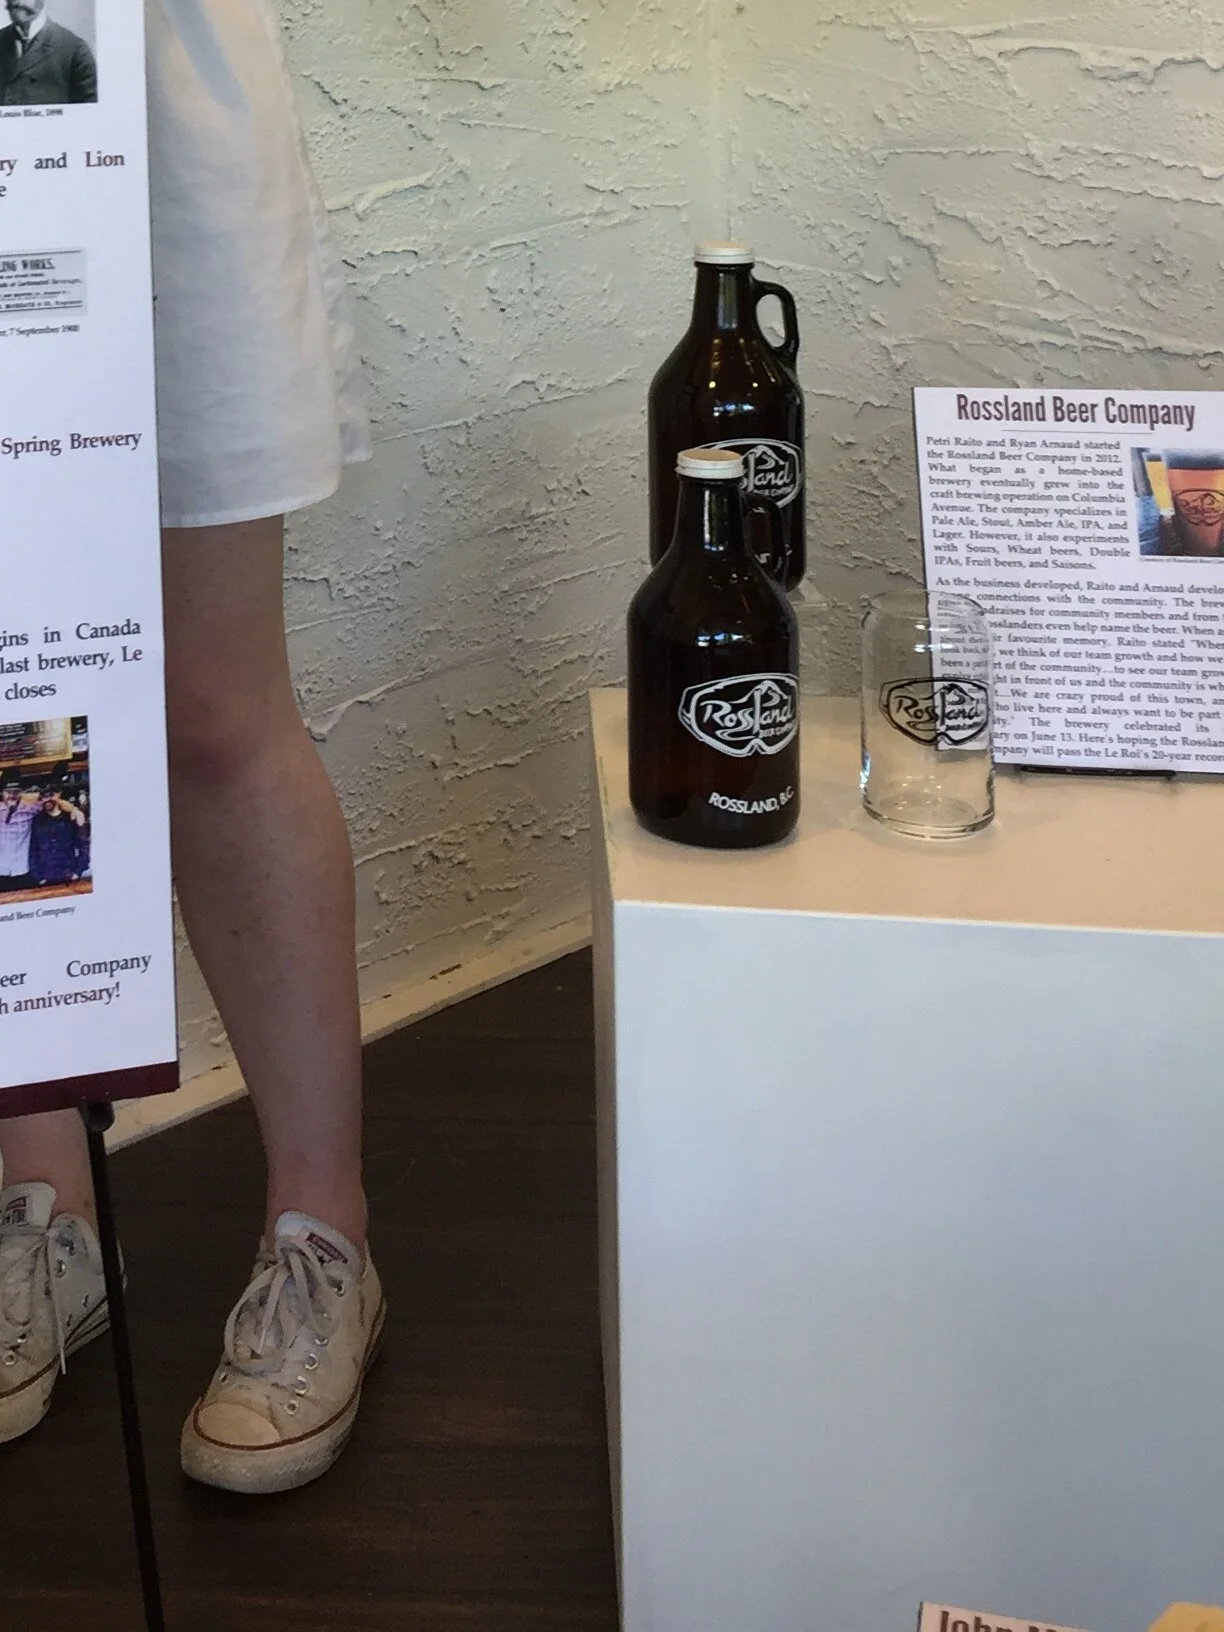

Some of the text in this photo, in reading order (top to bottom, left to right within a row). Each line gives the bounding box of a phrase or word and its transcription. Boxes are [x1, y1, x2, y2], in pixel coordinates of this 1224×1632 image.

[34, 152, 67, 169] and
[85, 151, 125, 167] Lion
[957, 394, 1195, 432] Rossland Beer Company
[708, 792, 779, 814] ROSSLAND,
[66, 955, 152, 978] Company
[13, 982, 120, 1012] anniversary!
